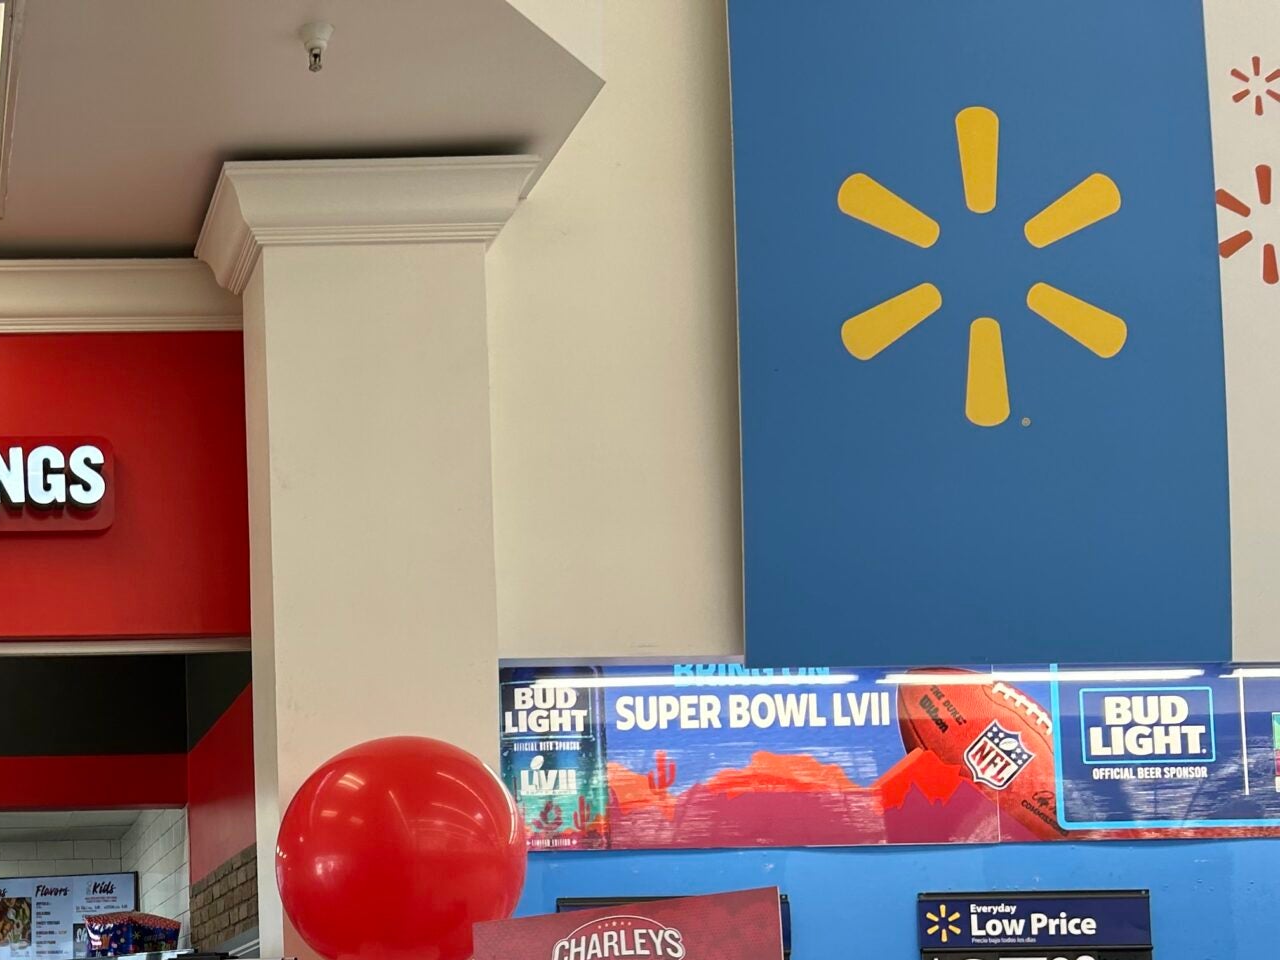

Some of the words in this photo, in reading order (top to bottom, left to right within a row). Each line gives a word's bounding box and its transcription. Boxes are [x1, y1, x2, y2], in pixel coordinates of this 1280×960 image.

[514, 687, 578, 710] BUD
[1104, 695, 1189, 725] BUD
[504, 709, 588, 733] LIGHT
[615, 695, 722, 731] SUPER
[729, 693, 826, 729] BOWL
[833, 691, 890, 727] LVII
[972, 740, 1014, 784] NFL
[1093, 767, 1136, 780] OFFICIAL
[1137, 767, 1162, 779] BEER
[1163, 766, 1208, 779] SPONSOR
[35, 885, 70, 898] Flavors
[92, 881, 116, 895] Kids
[970, 904, 1017, 915] Everyday
[970, 914, 1025, 936] Low
[1030, 912, 1097, 936] Price
